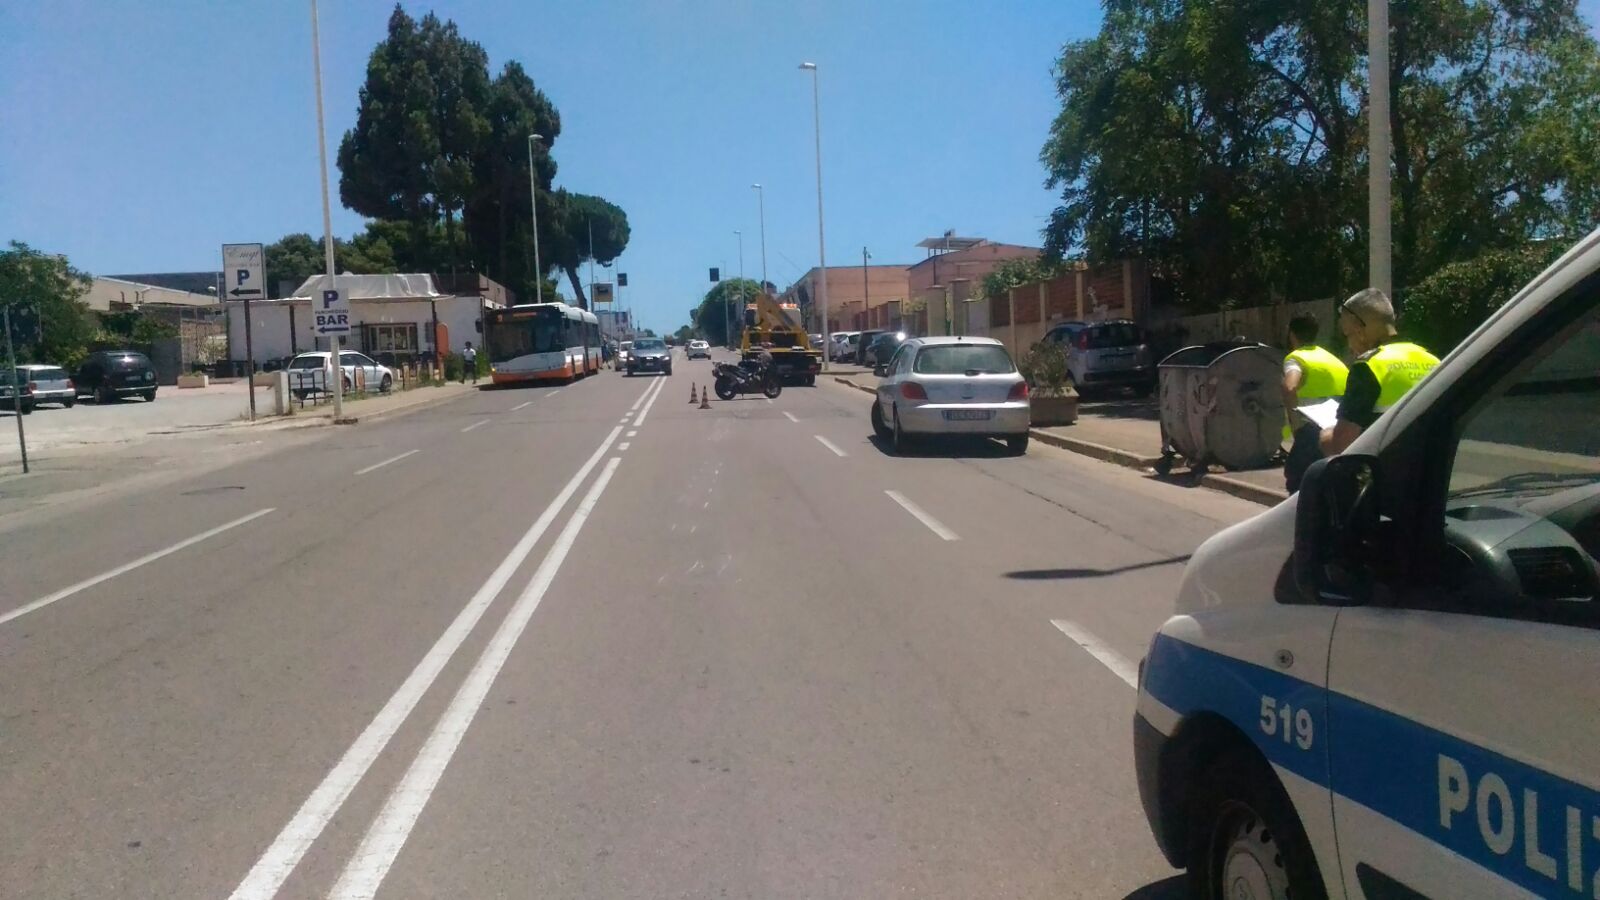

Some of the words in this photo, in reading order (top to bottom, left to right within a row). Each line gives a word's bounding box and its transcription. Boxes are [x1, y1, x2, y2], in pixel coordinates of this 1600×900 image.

[237, 269, 250, 285] P
[323, 290, 339, 308] P
[316, 314, 349, 326] BAR
[1260, 694, 1313, 750] 519
[1438, 753, 1600, 900] POLI
